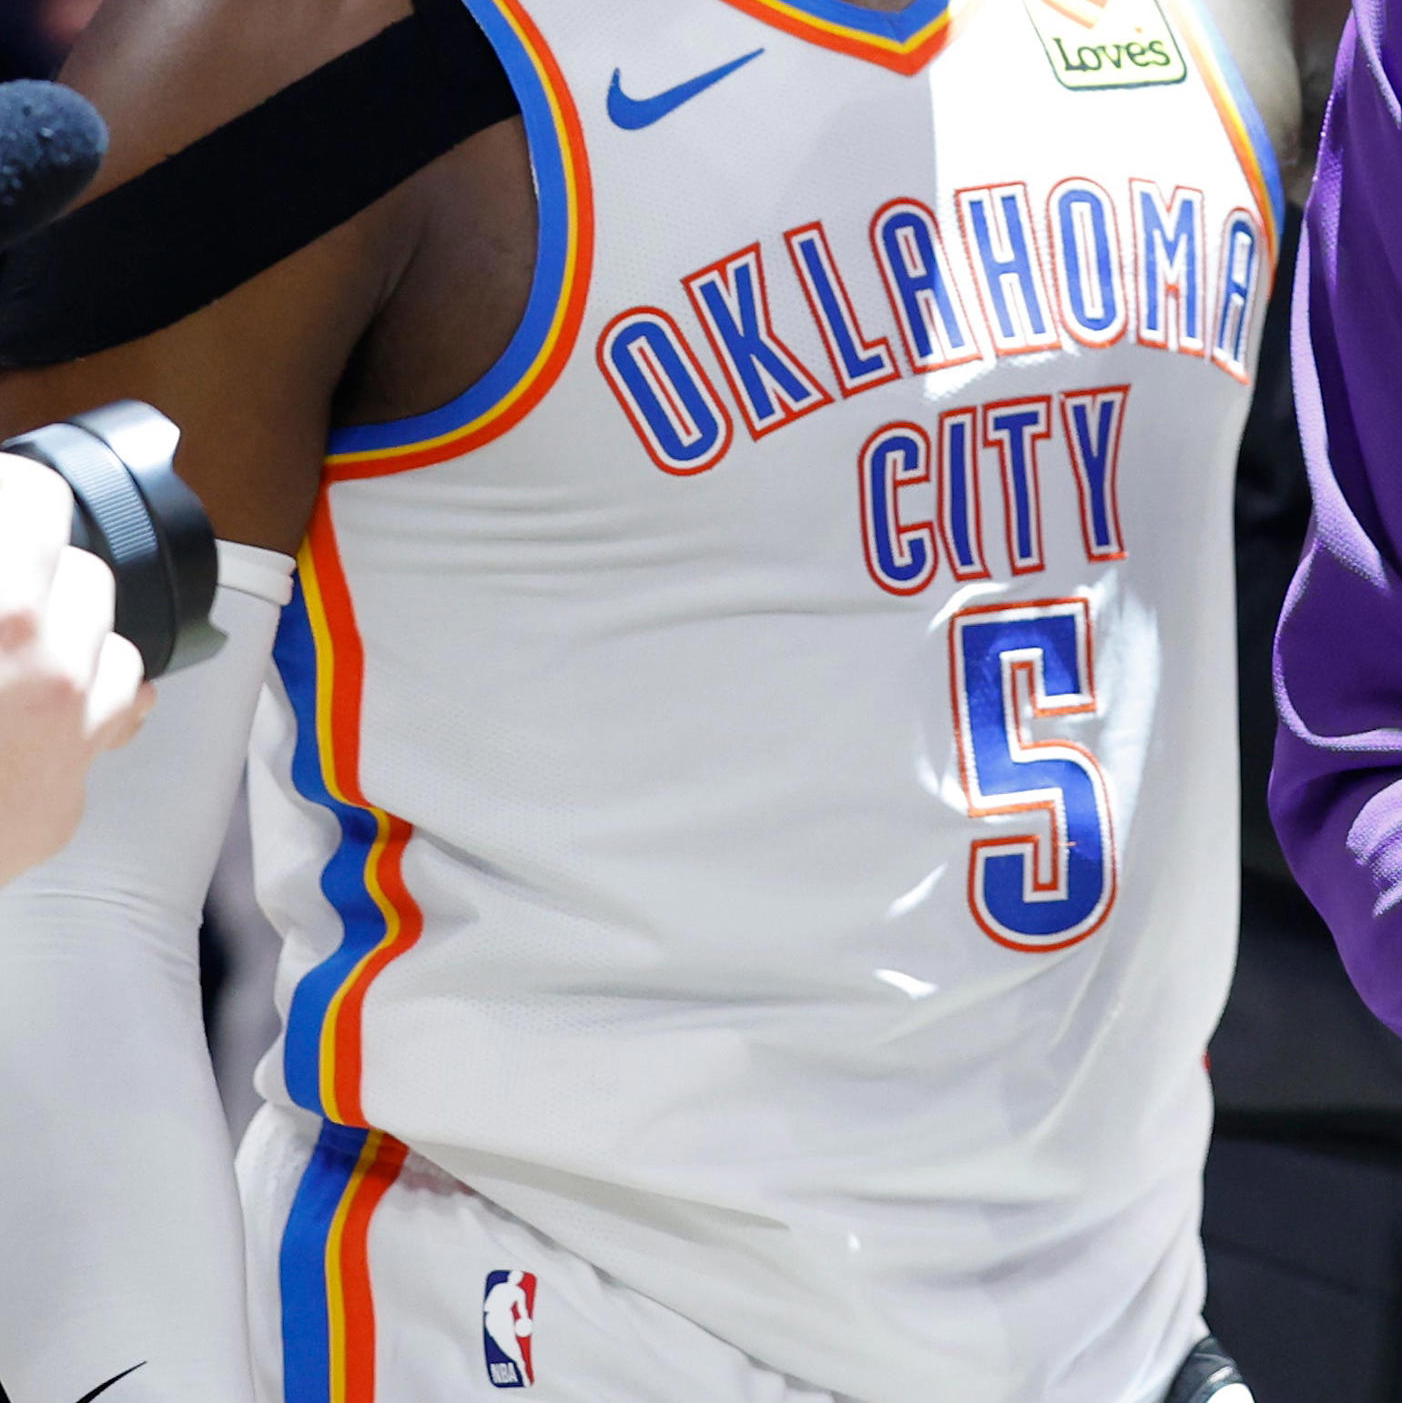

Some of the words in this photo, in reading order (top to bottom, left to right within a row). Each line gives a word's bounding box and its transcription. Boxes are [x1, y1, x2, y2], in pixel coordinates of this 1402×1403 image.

[596, 177, 1265, 476] OKLAHOMA
[857, 383, 1131, 596] CITY
[948, 597, 1119, 952] 5
